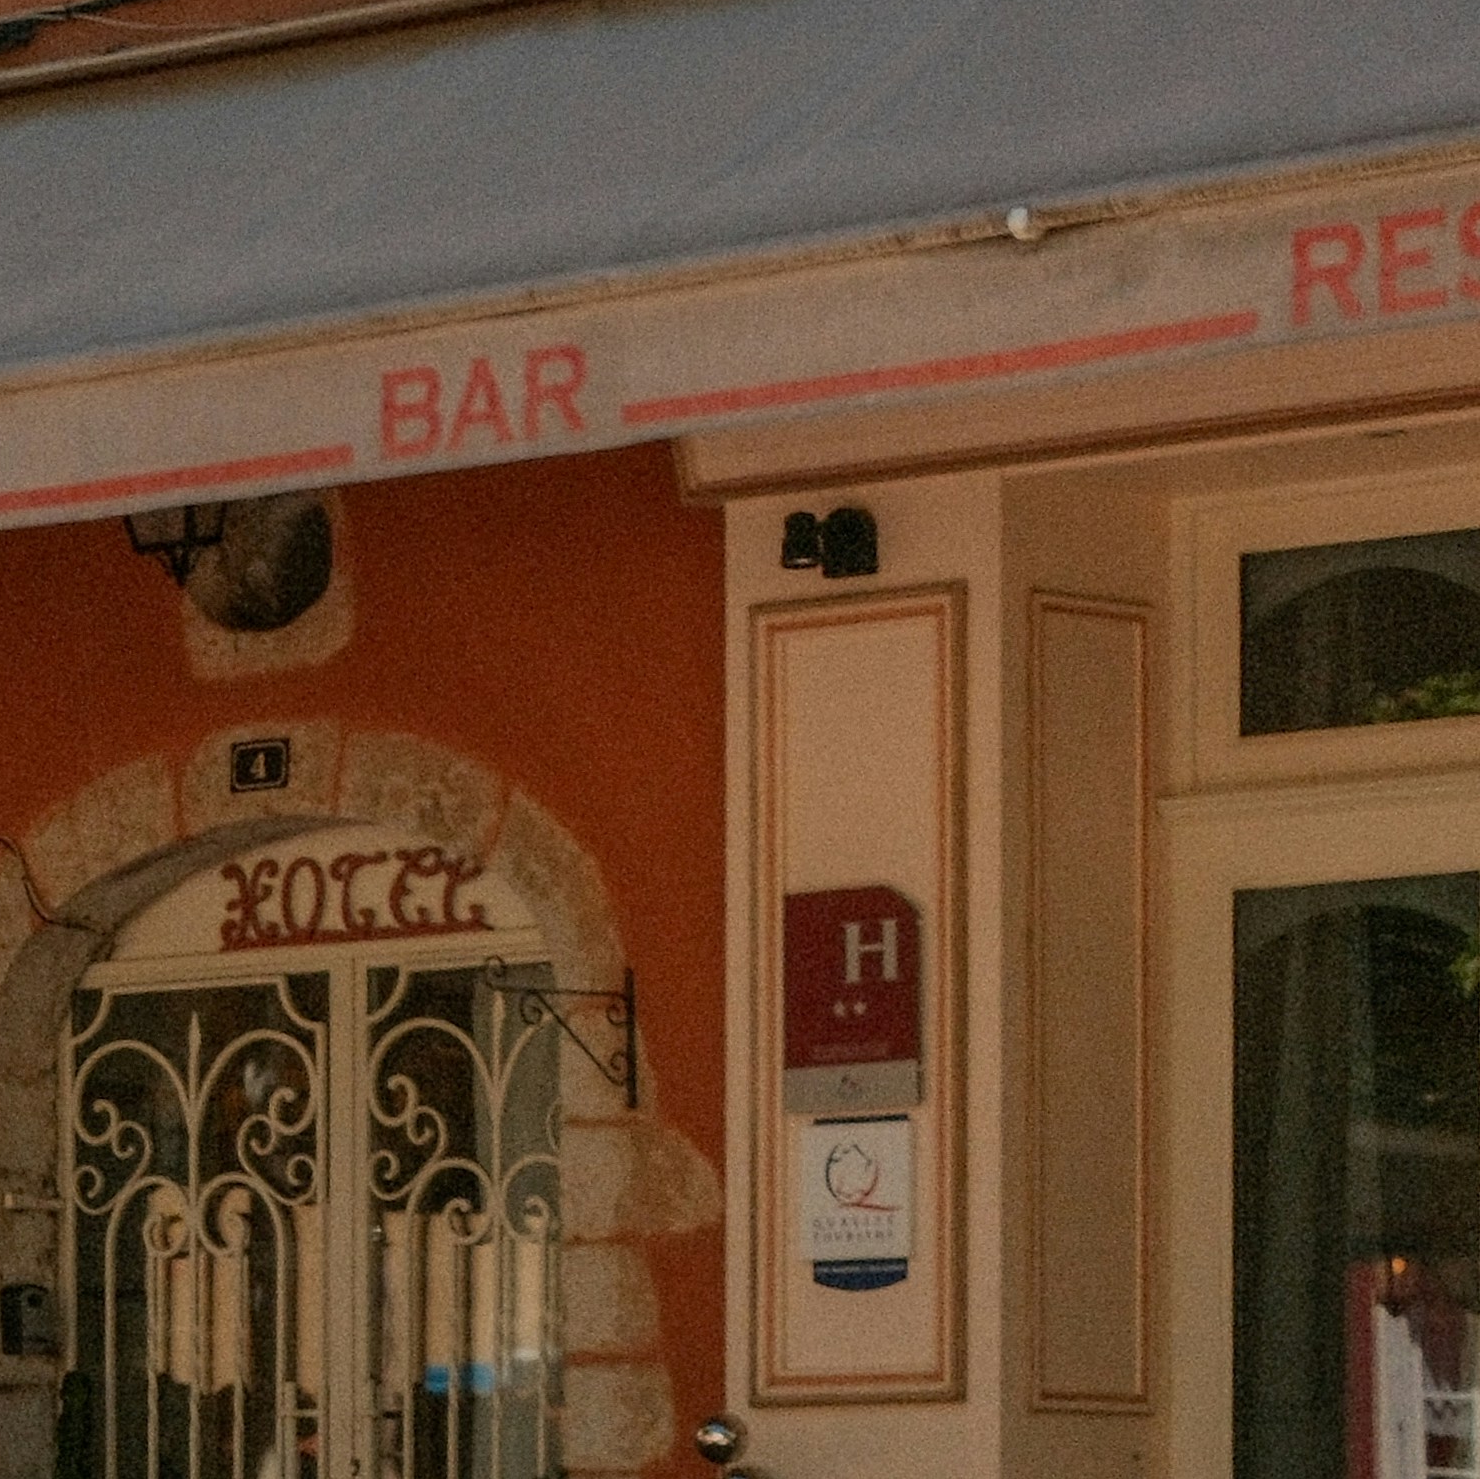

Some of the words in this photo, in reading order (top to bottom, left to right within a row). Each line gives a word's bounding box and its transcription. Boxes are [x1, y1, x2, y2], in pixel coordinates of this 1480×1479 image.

[377, 341, 588, 464] BAR
[250, 753, 267, 780] 4
[844, 921, 899, 984] H
